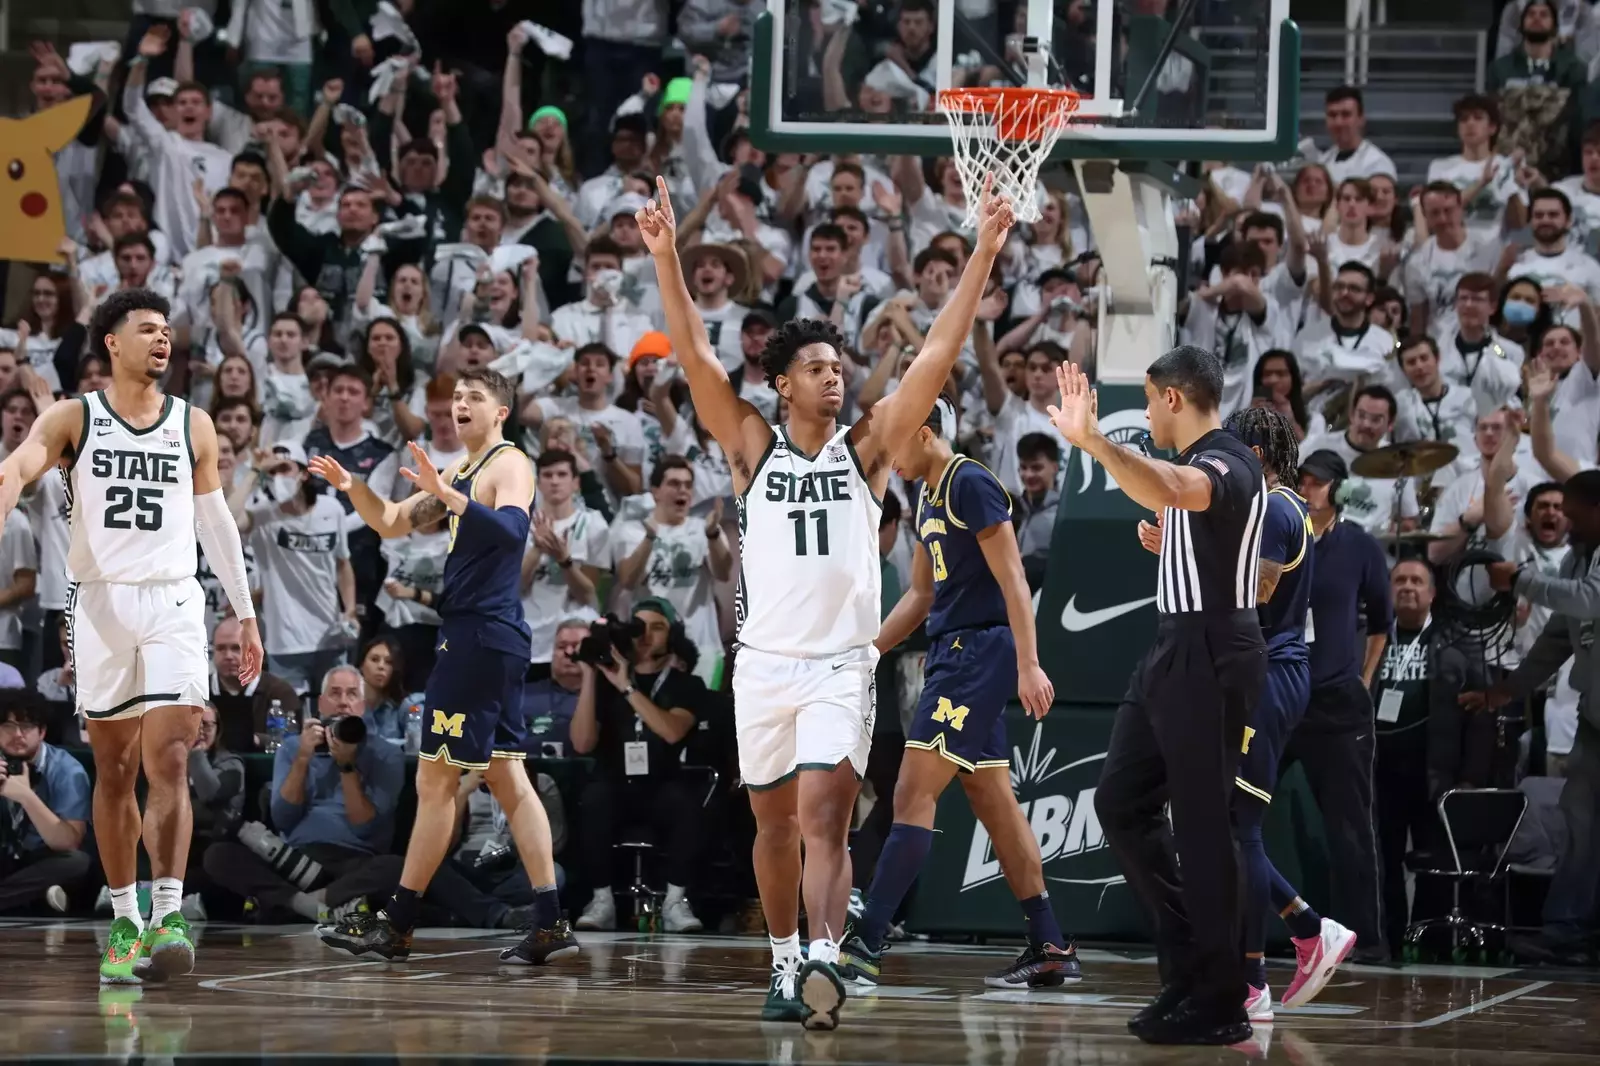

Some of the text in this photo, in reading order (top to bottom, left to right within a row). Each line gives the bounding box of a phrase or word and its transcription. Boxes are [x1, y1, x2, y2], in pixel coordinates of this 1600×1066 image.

[92, 449, 181, 484] STATE
[765, 469, 852, 503] STATE
[104, 485, 164, 531] 25
[787, 508, 829, 556] 11
[431, 709, 466, 738] M
[931, 696, 970, 731] M
